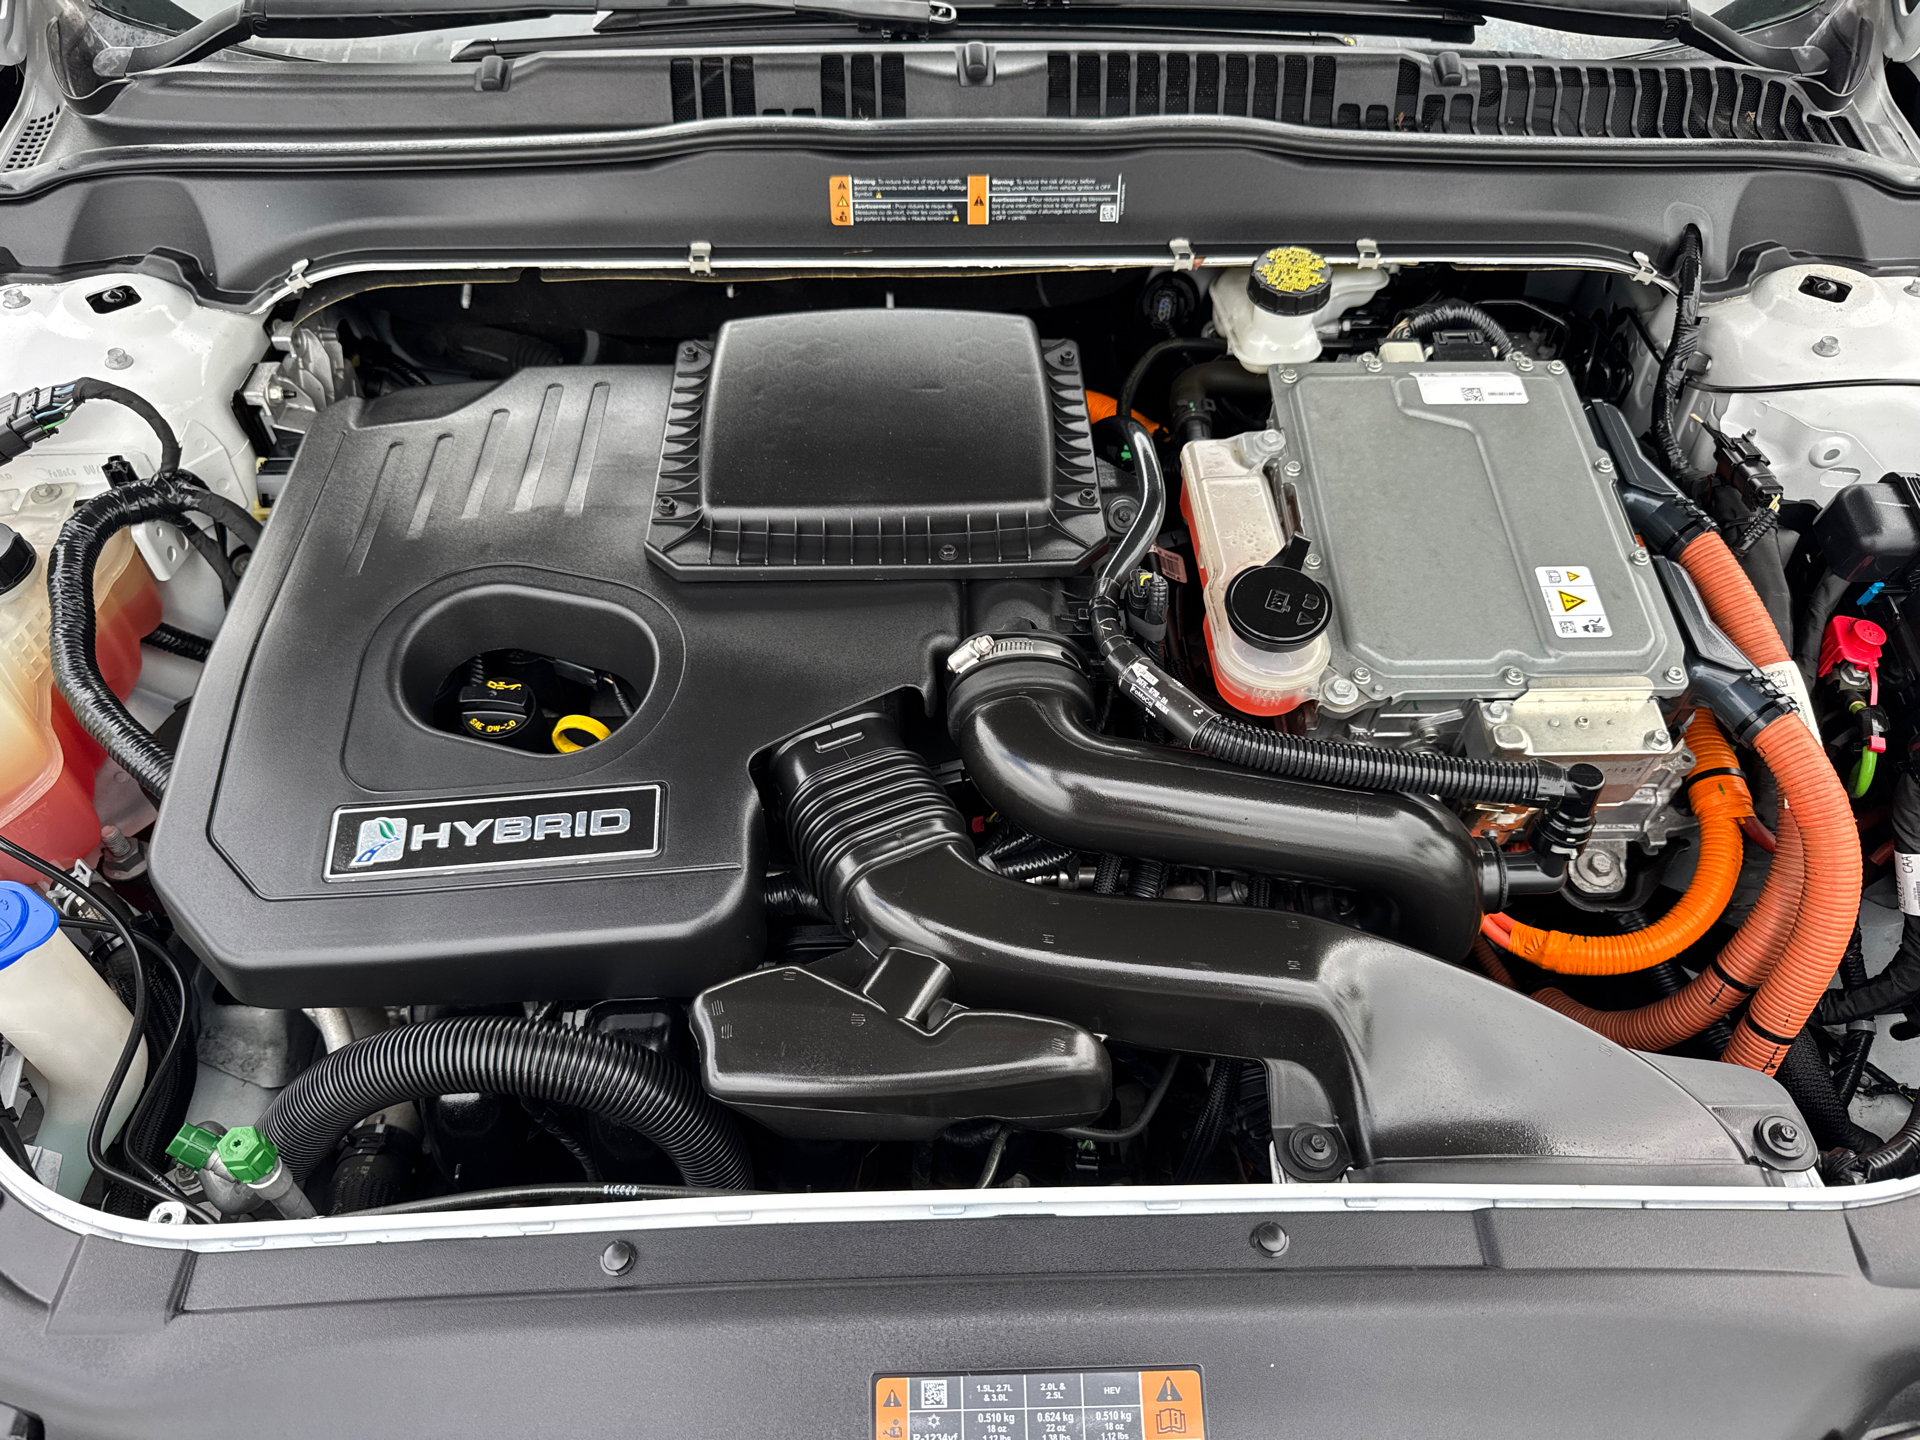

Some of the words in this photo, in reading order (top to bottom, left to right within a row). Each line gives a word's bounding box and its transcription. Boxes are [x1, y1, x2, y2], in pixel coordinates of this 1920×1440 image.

[470, 718, 485, 730] SAE
[410, 808, 630, 850] HYBRID
[1902, 856, 1914, 874] CAA
[978, 1413, 1001, 1423] 0.510
[1003, 1413, 1014, 1424] kg
[1037, 1412, 1061, 1422] 0.624
[1062, 1412, 1074, 1423] kg
[1096, 1411, 1118, 1421] 0.510
[1121, 1411, 1131, 1422] kg
[1118, 1432, 1129, 1440] lbs
